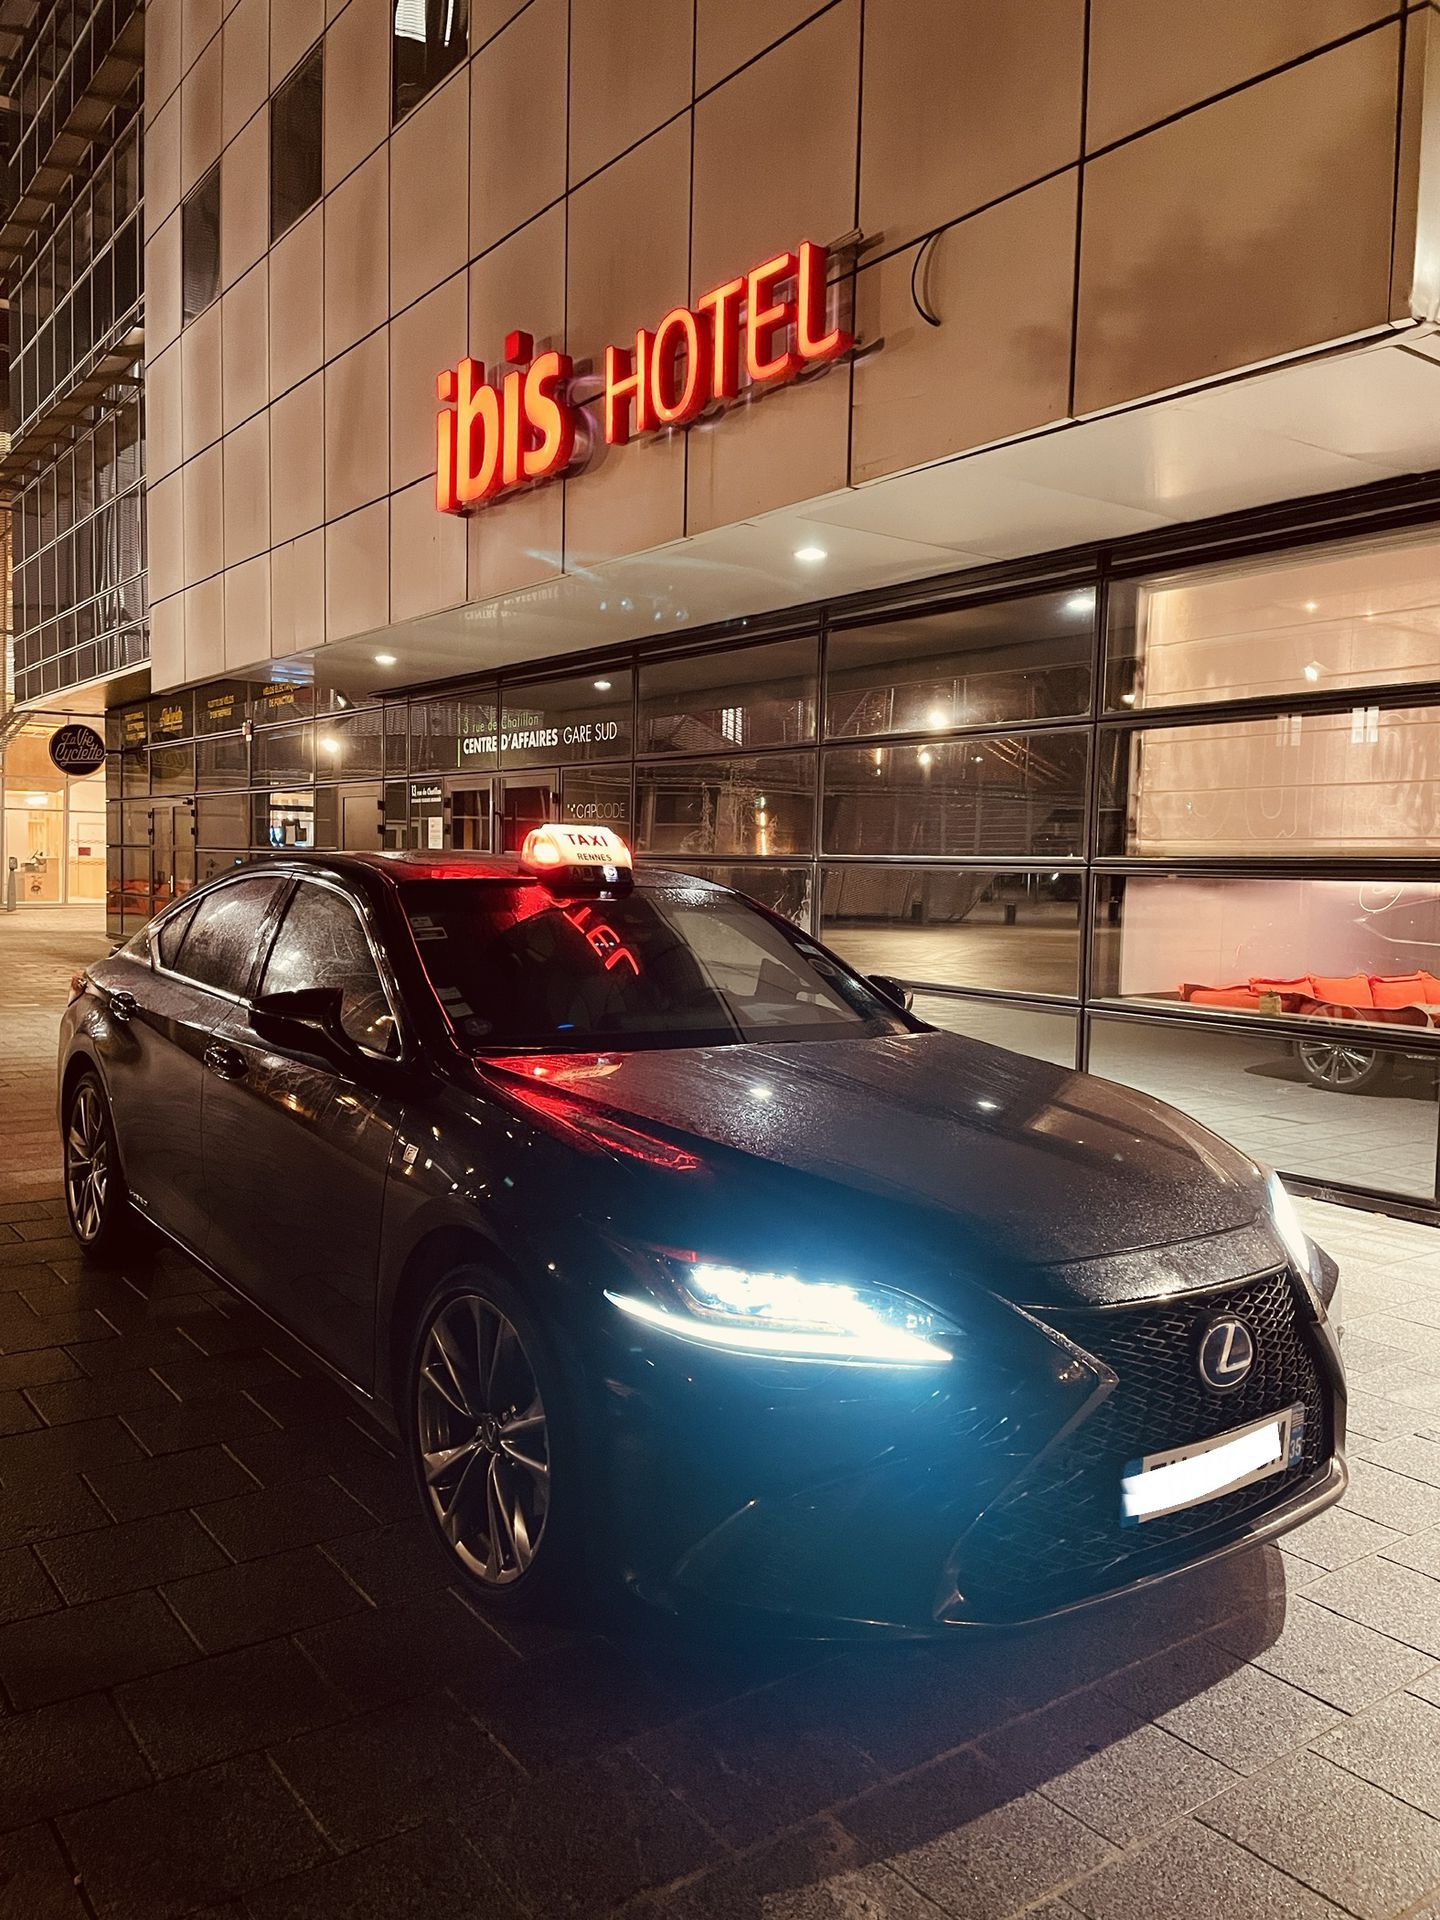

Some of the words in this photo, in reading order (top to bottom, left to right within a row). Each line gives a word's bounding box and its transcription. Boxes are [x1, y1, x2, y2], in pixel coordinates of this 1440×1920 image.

[436, 330, 575, 514] ibis
[605, 241, 854, 445] HOTEL
[472, 720, 485, 732] rue
[487, 717, 497, 731] de
[61, 732, 76, 745] La
[77, 728, 95, 747] Vie
[463, 736, 497, 755] CENTRE
[501, 728, 558, 750] D'AFFAIRES
[563, 724, 591, 745] GARE
[595, 721, 618, 740] SUD
[576, 803, 625, 818] CAPCODE
[563, 833, 608, 847] TAXI
[577, 853, 612, 862] RENNES
[1289, 1437, 1302, 1459] 35
